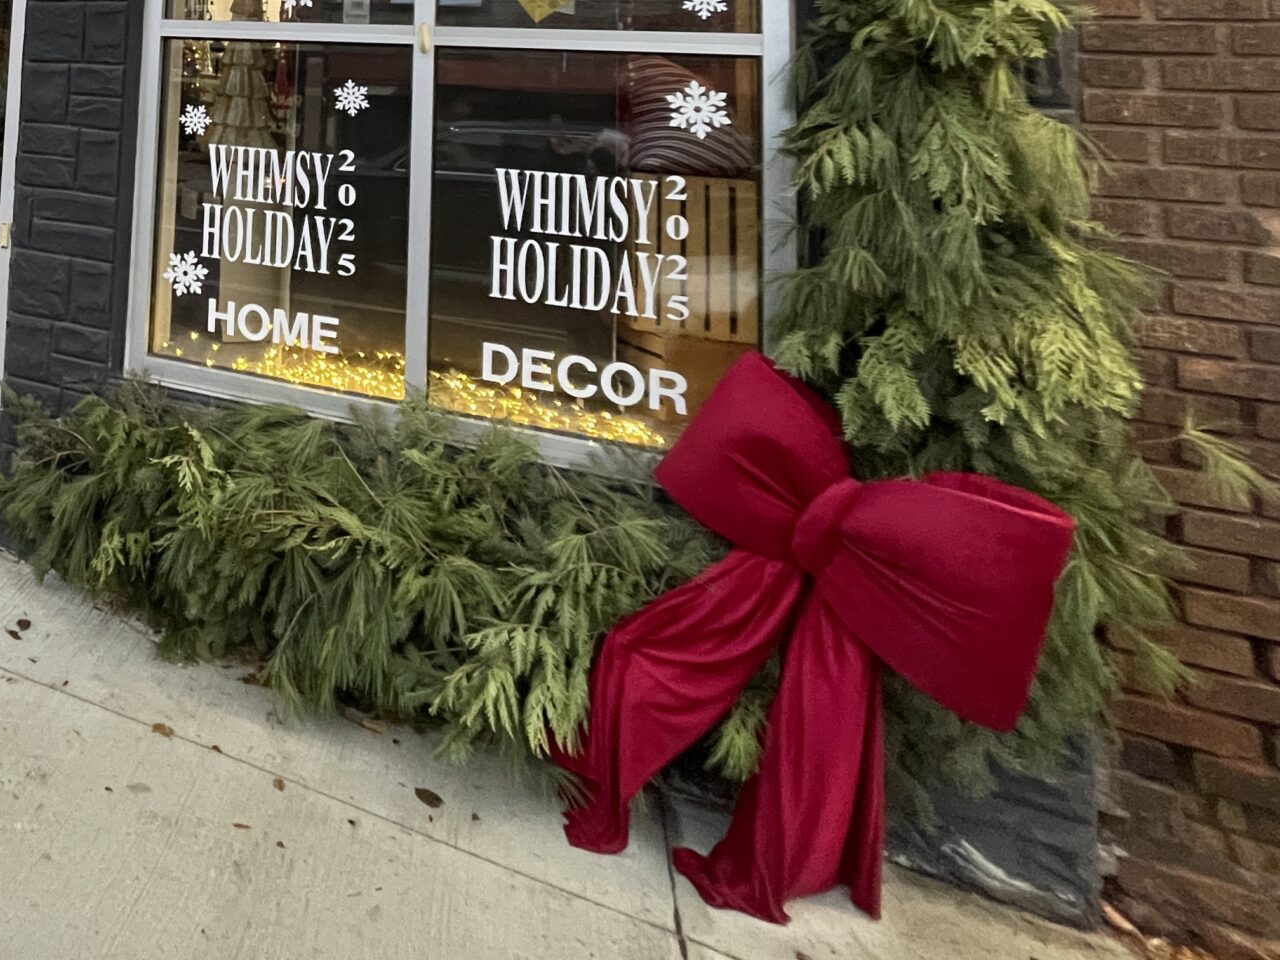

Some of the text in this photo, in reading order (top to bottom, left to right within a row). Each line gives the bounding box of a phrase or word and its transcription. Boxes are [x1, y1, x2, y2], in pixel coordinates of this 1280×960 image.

[209, 143, 334, 210] WHIMSY
[496, 167, 658, 245] WHIMSY
[200, 202, 336, 275] HOLIDAY
[489, 236, 665, 320] HOLIDAY
[207, 298, 340, 355] HOME
[482, 342, 688, 416] DECOR
